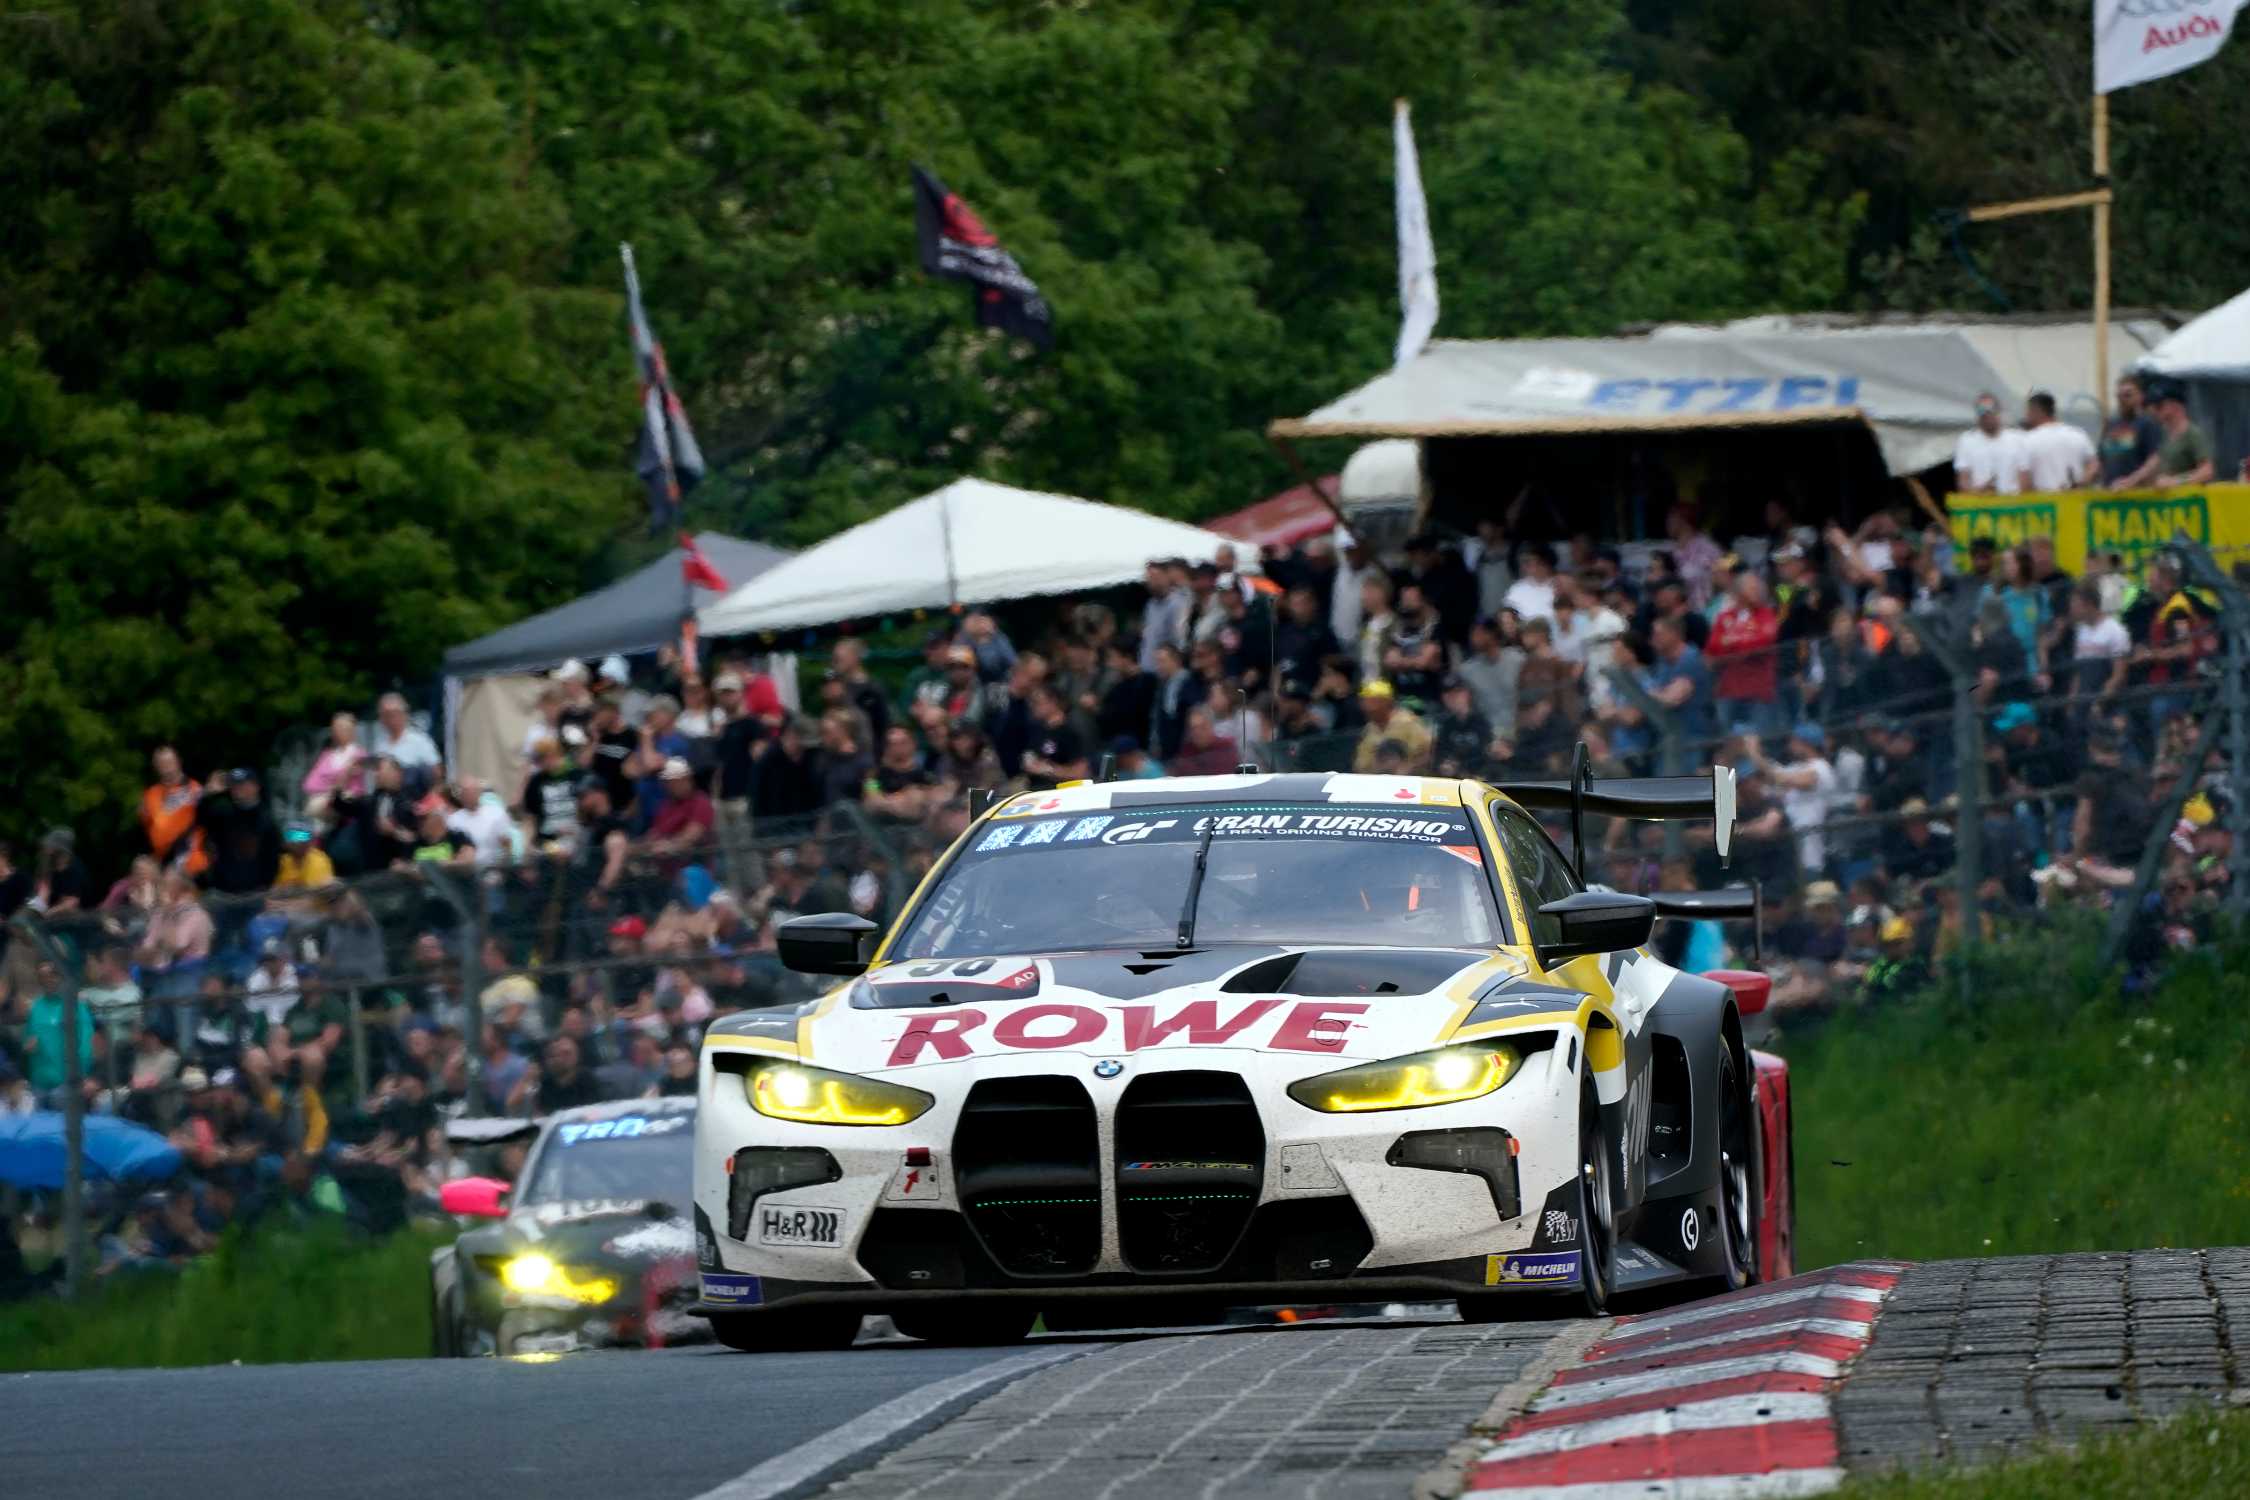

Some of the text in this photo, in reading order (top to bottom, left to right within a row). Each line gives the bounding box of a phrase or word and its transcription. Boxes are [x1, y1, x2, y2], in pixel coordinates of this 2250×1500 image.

[2091, 505, 2200, 544] MANN
[1193, 814, 1293, 831] GRAN
[1276, 828, 1344, 836] DRIVING
[1347, 830, 1442, 843] SIMULATOR
[886, 999, 1371, 1067] ROWE
[763, 1209, 808, 1238] H&R
[1524, 1261, 1576, 1277] MICHELIN
